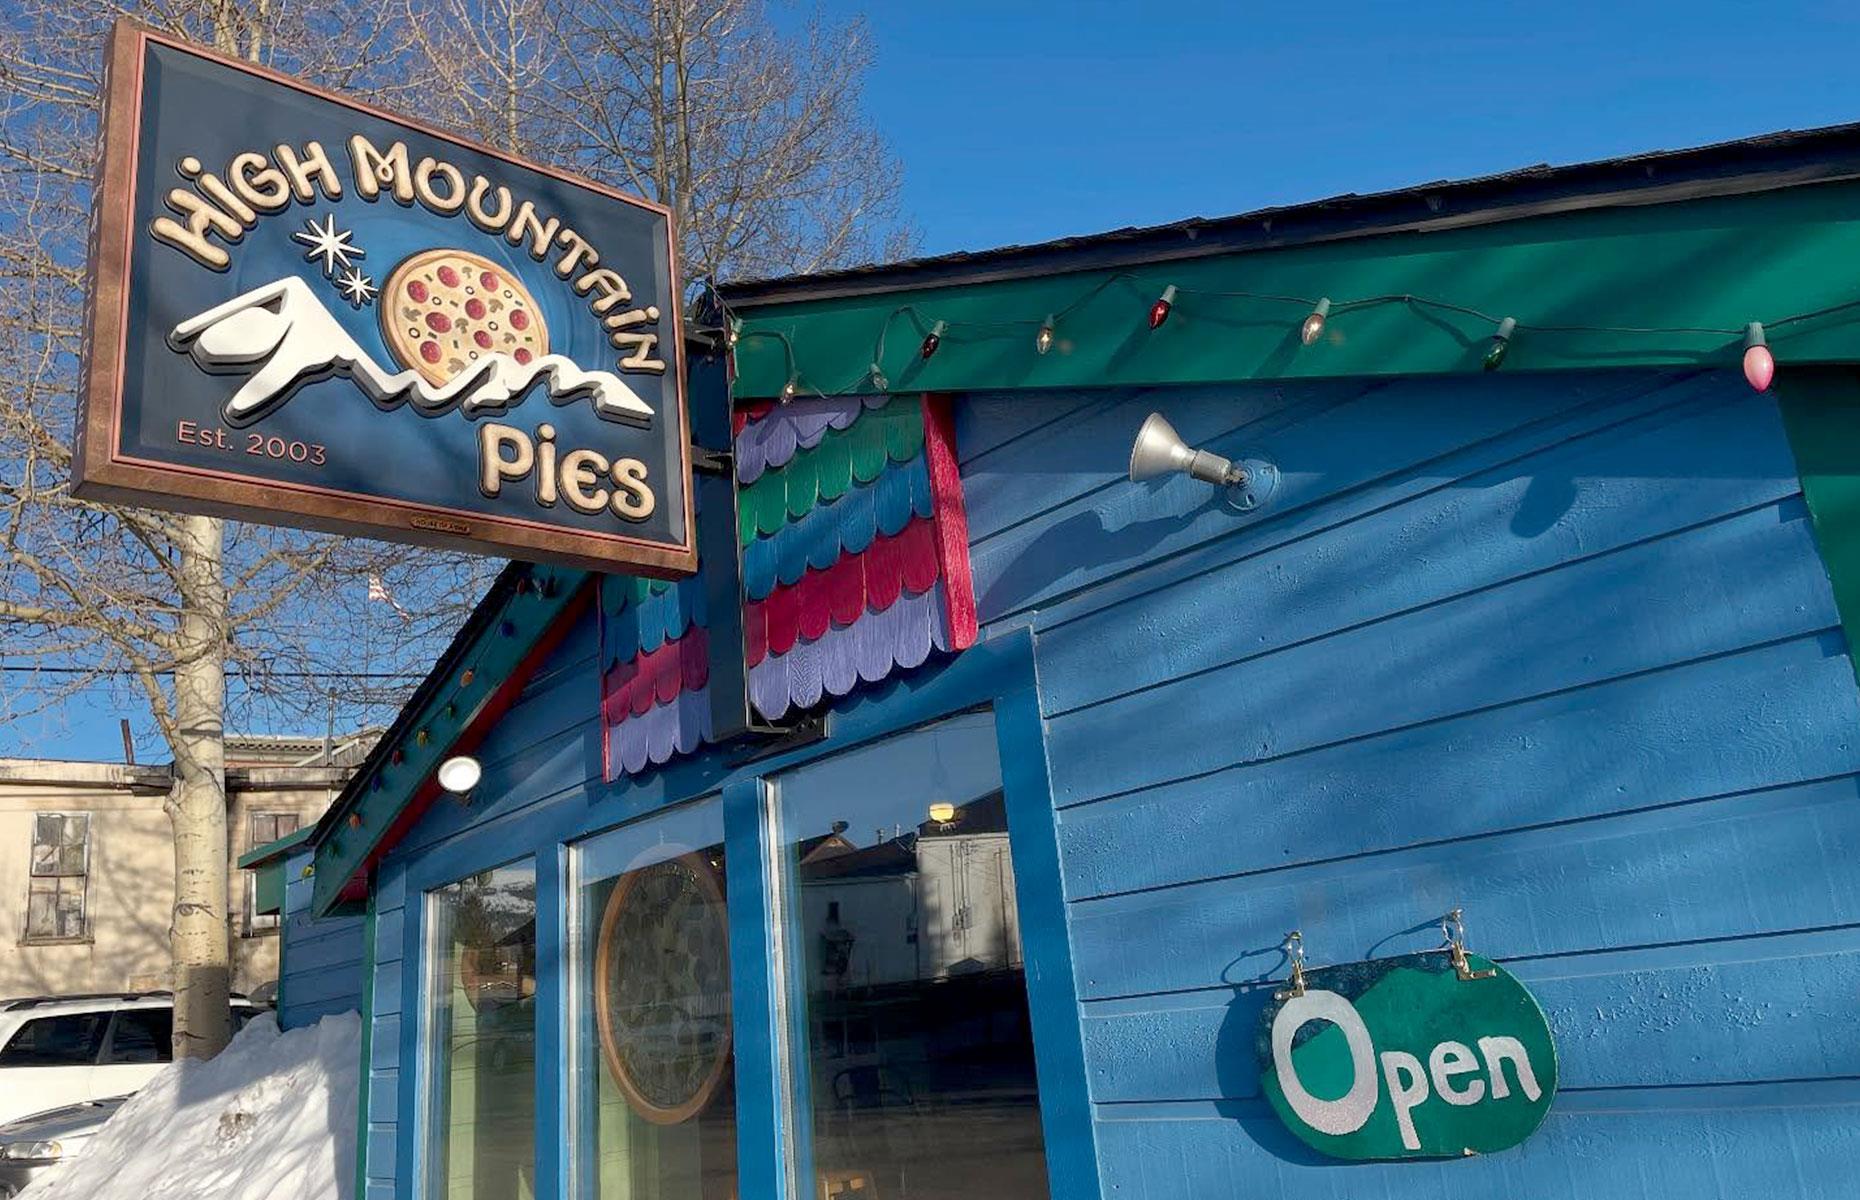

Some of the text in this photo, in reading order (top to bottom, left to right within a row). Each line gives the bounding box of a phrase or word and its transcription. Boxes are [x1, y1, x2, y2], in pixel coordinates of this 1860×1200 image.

[177, 420, 326, 465] Est. 2003
[1272, 990, 1542, 1150] Open
